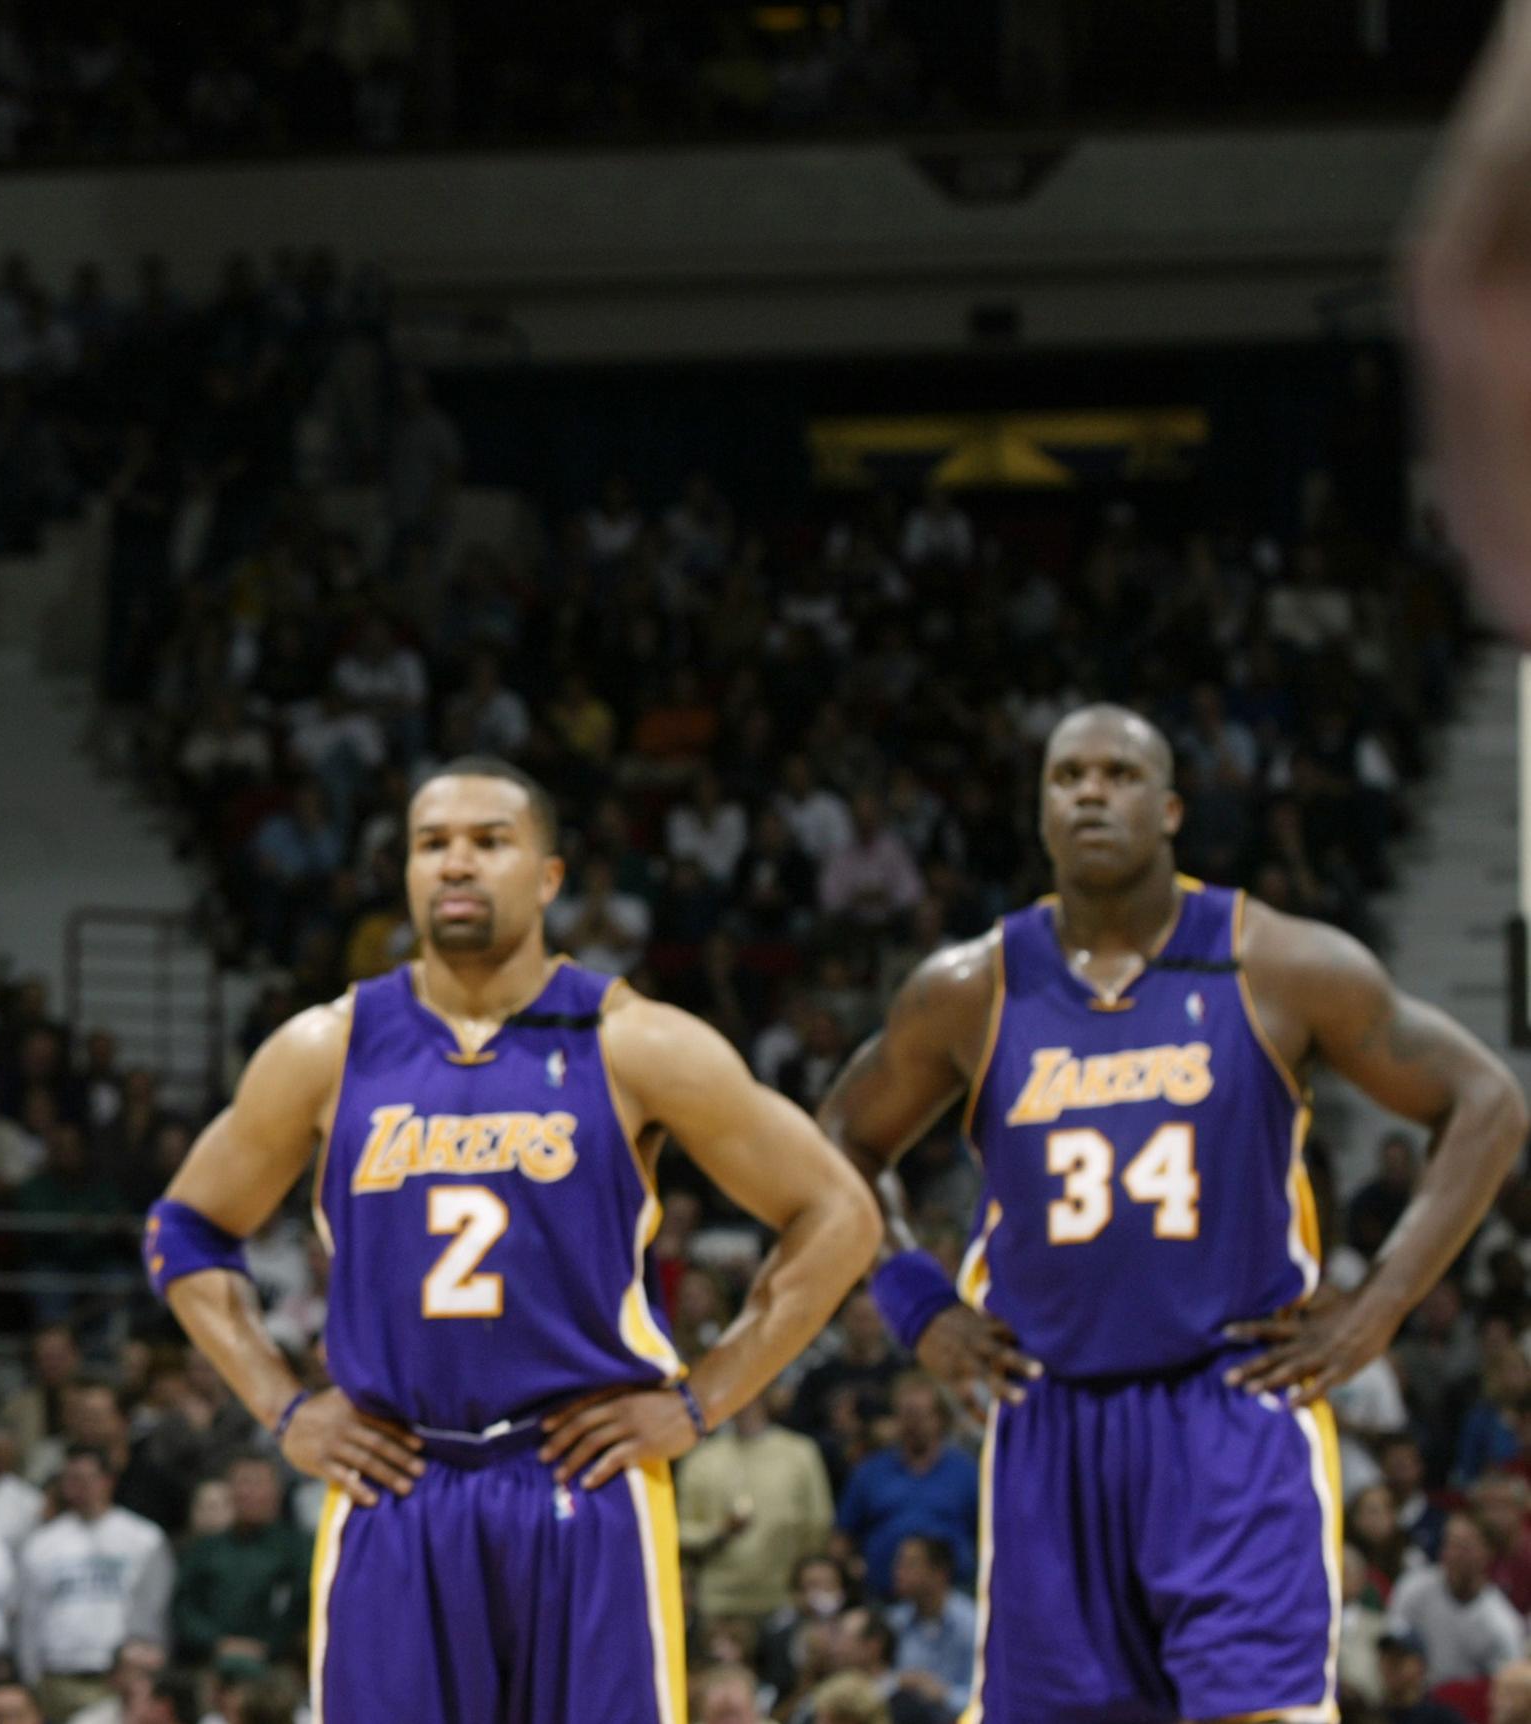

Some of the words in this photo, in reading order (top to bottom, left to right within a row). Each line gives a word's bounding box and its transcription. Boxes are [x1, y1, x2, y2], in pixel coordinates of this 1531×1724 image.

[1006, 1041, 1214, 1127] LAKERS
[350, 1103, 578, 1195] LAKERS
[1046, 1121, 1201, 1244] 34
[422, 1184, 509, 1319] 2
